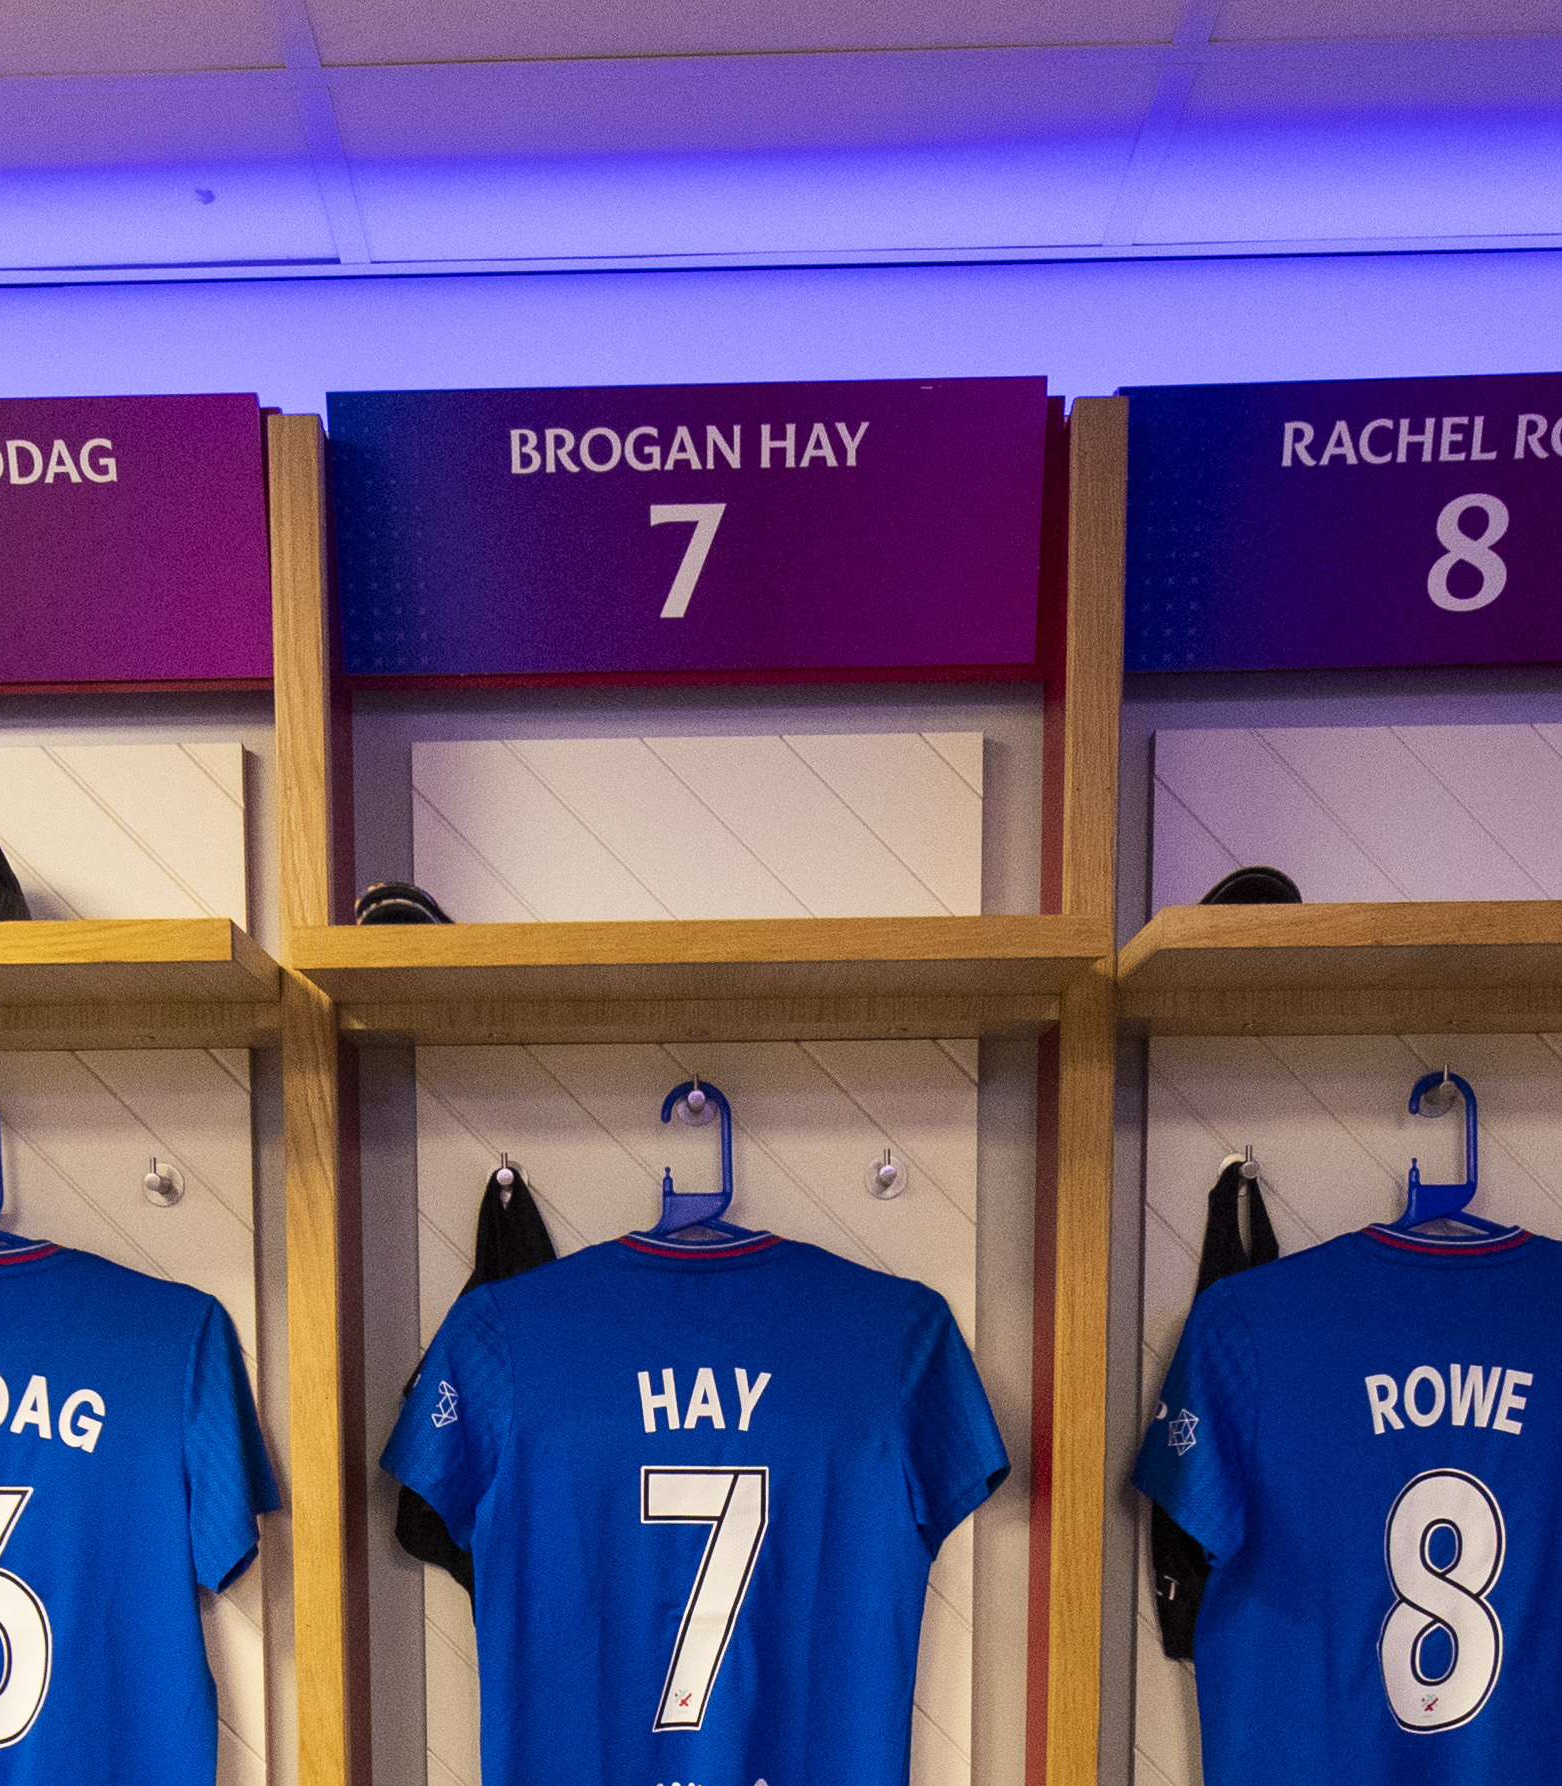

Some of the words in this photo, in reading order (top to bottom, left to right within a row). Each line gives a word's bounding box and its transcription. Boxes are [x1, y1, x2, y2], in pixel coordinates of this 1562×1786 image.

[509, 424, 742, 475] BROGAN
[760, 421, 871, 469] HAY
[1281, 415, 1498, 468] RACHEL
[649, 502, 727, 619] 7
[1426, 492, 1510, 613] 8
[637, 1366, 772, 1434] HAY
[1363, 1363, 1534, 1437] ROWE
[638, 1465, 771, 1734] 7
[1380, 1466, 1508, 1736] 8
